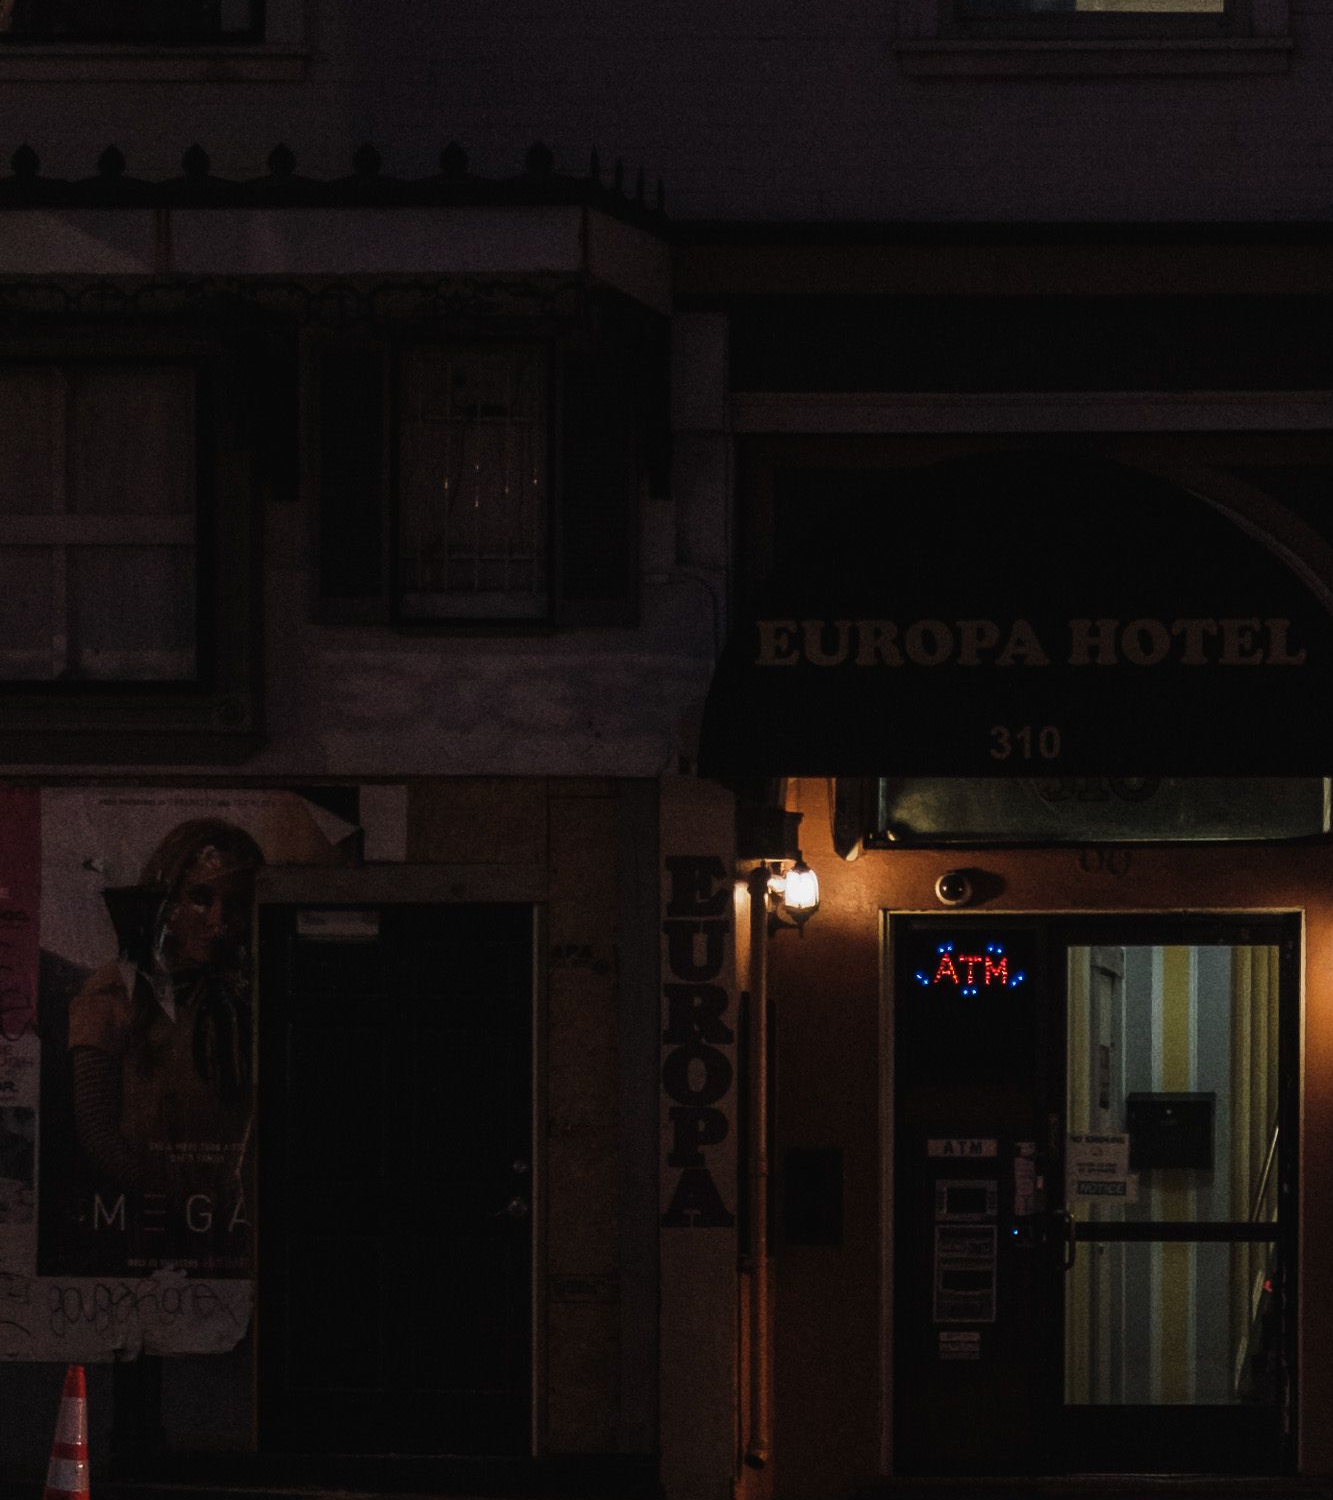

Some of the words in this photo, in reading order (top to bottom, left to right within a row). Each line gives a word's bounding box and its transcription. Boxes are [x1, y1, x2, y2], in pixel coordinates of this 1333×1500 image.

[755, 618, 1050, 669] EUROPA
[1068, 618, 1307, 669] HOTEL
[989, 725, 1062, 760] 310
[932, 953, 1009, 988] ATM
[662, 855, 735, 1228] EUROPA
[942, 1141, 984, 1155] ATM
